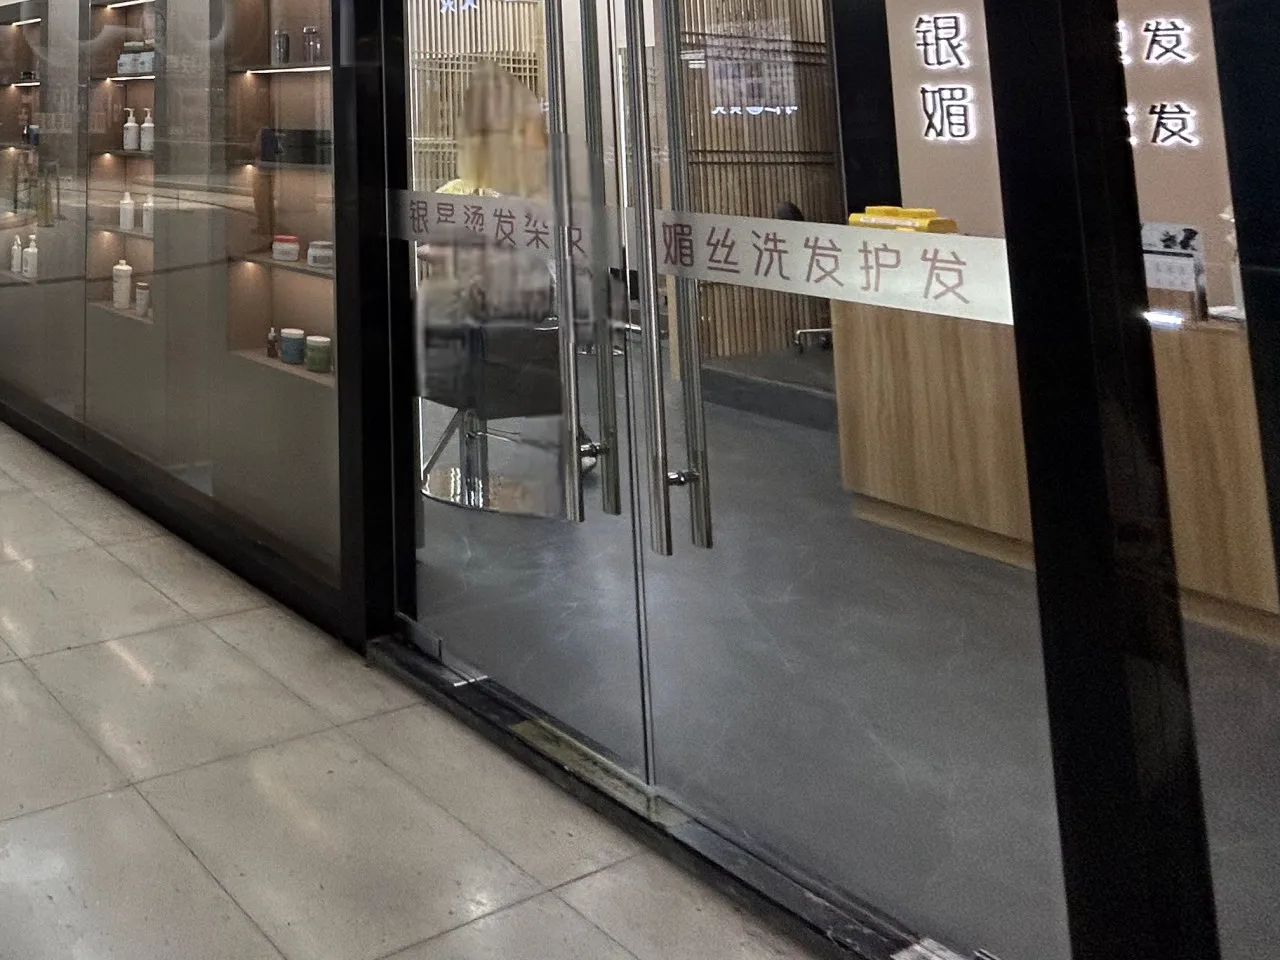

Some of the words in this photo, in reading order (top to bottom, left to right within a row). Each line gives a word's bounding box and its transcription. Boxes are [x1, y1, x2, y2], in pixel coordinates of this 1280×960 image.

[661, 221, 970, 305] 媚丝洗发护发
